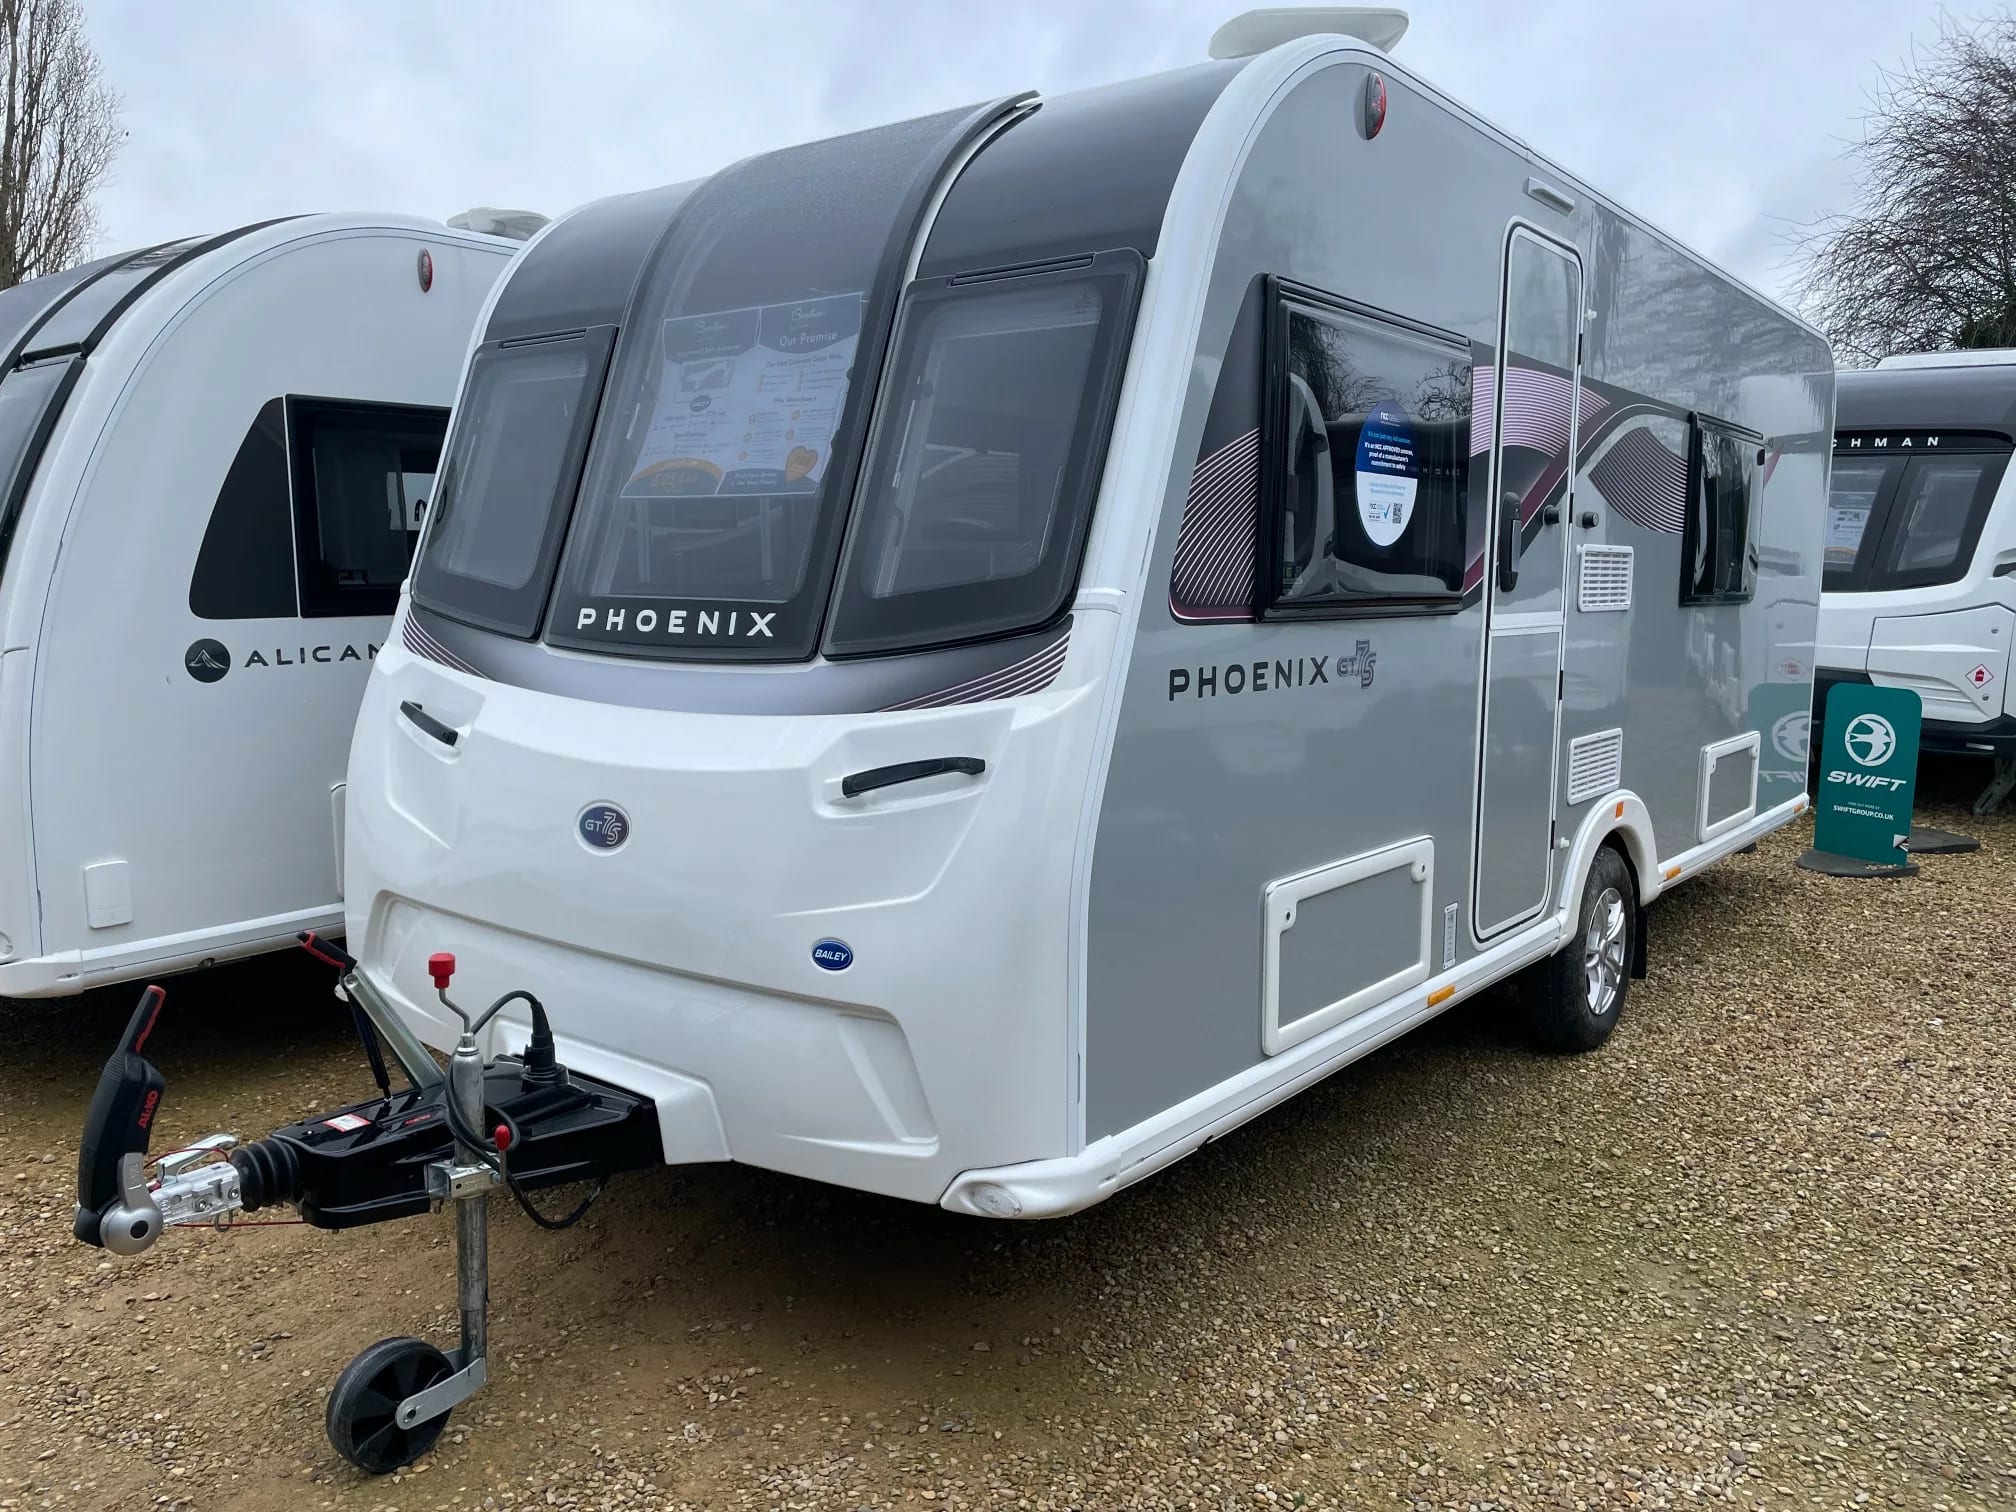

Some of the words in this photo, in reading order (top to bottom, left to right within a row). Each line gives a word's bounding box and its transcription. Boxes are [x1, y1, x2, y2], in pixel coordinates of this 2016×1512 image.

[779, 335, 797, 346] Our
[799, 331, 838, 345] Promise
[577, 607, 776, 637] PHOENIX
[1169, 655, 1329, 701] PHOENIX
[1827, 770, 1907, 791] SWIFT
[1833, 804, 1894, 821] SWIFTGROUP.CO.UK
[814, 949, 848, 962] BAILEY
